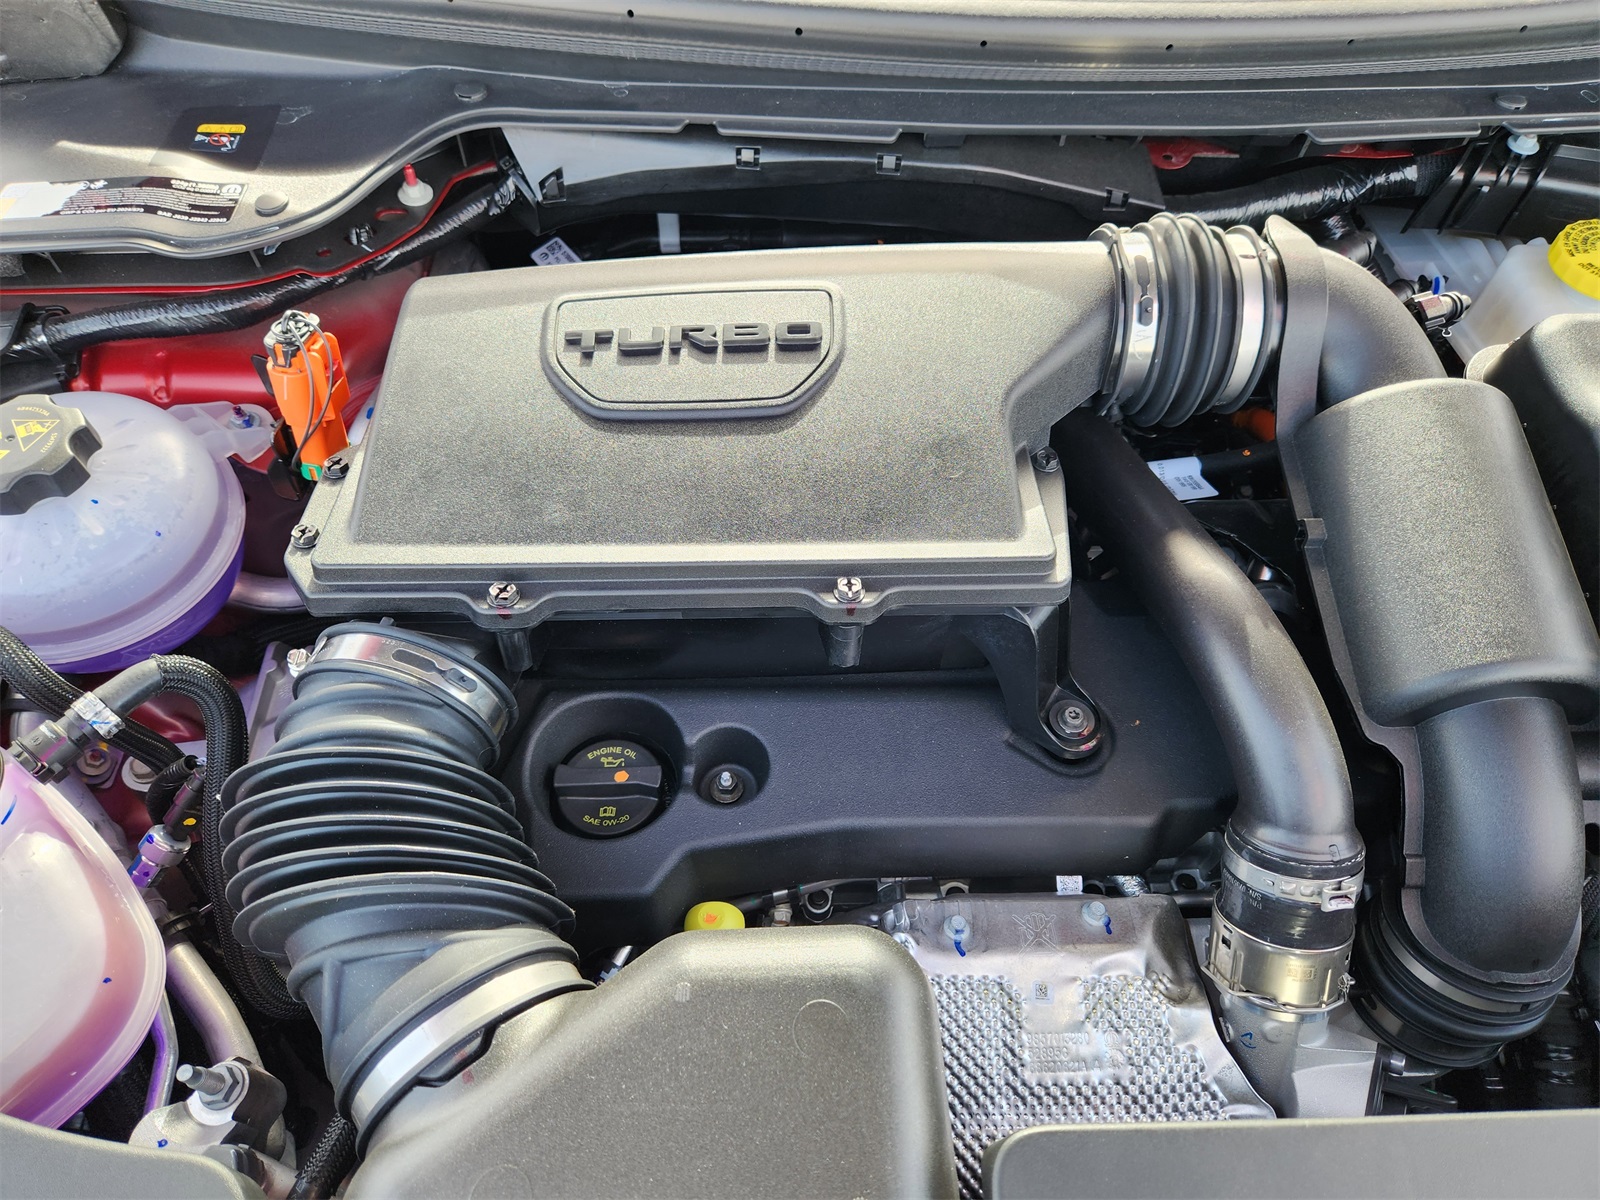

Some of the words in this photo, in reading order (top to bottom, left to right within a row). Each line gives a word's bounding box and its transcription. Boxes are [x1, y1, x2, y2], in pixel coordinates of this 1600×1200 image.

[564, 321, 824, 356] TURBO
[587, 746, 623, 760] ENGINE
[624, 748, 638, 760] OIL
[582, 814, 602, 826] SAE
[602, 814, 630, 827] 0W-20
